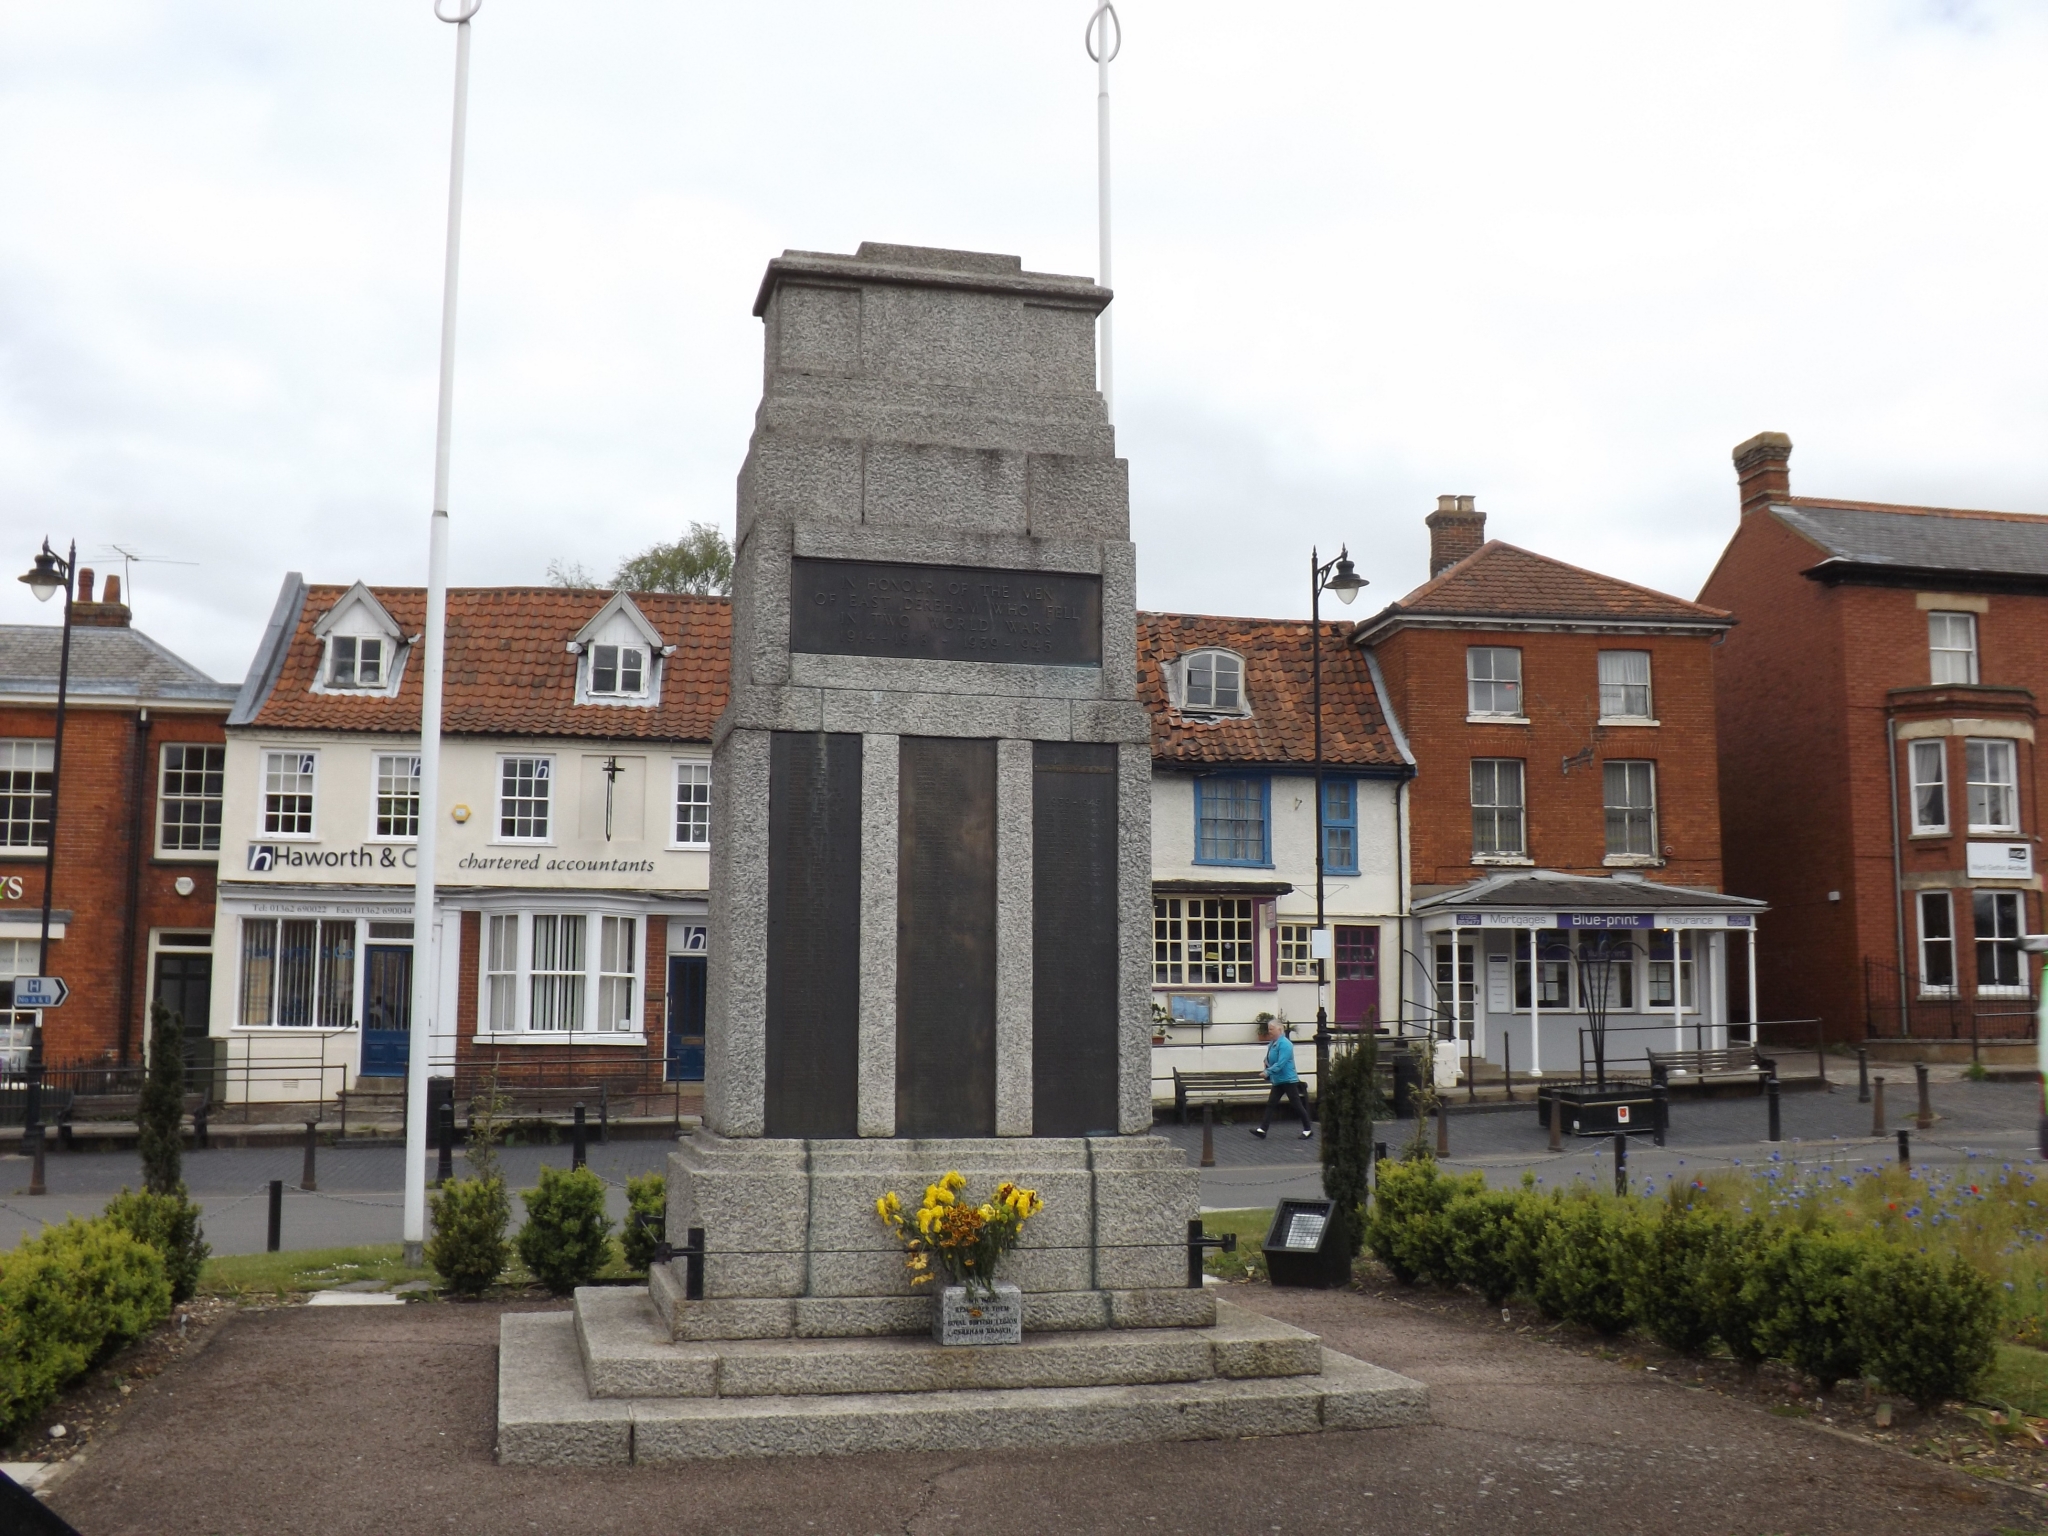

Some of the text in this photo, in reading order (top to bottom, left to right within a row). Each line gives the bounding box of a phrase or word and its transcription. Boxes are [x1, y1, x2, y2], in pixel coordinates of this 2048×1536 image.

[840, 577, 1054, 602] IN HONOUR OF THE MEN
[815, 592, 1080, 620] OF EAST DEREHAM WHO FELL
[840, 612, 1053, 635] IN TWO WORLD WARS
[275, 846, 372, 867] Haworth
[380, 847, 396, 868] &
[458, 852, 655, 873] chartered accountants
[252, 904, 412, 915] Tel: 01362 690022 Fax: 01362 690044
[1490, 914, 1546, 926] Mortgages
[1572, 914, 1639, 927] Blue-print
[1666, 915, 1714, 925] Insurance
[18, 995, 29, 1004] No
[31, 996, 38, 1004] A
